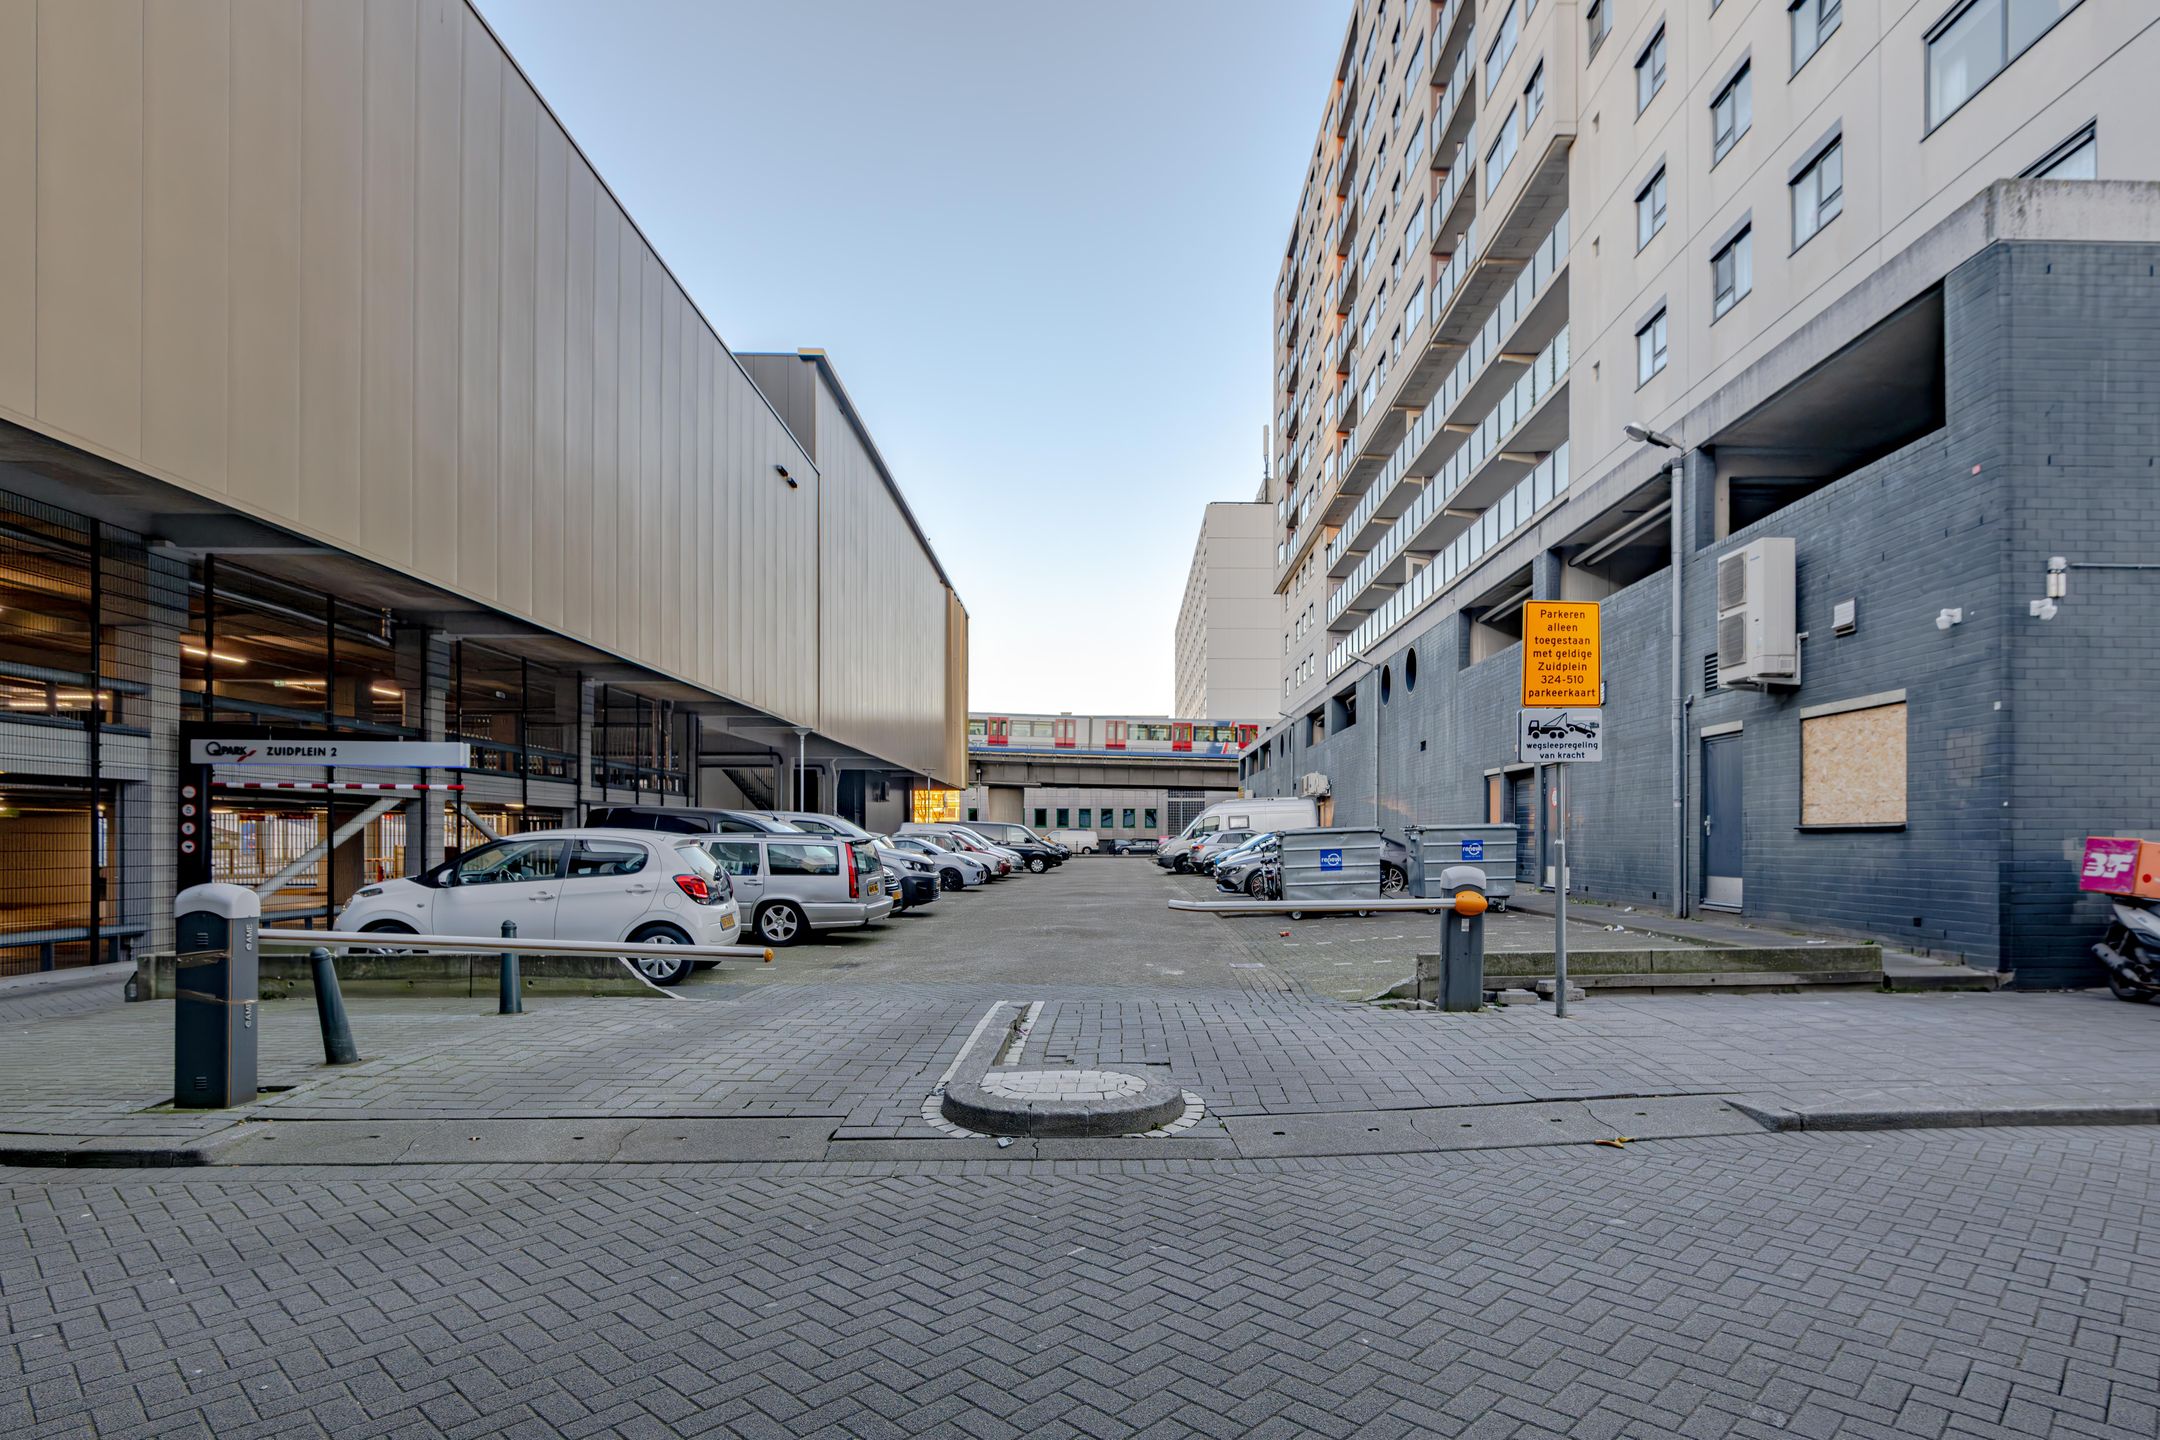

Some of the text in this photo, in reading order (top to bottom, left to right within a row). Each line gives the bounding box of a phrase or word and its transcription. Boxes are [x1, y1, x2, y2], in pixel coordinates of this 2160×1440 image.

[1541, 610, 1585, 619] Parkeren
[1547, 622, 1578, 632] alleen
[1535, 636, 1590, 646] toegestaan
[1533, 649, 1592, 660] met geldige
[1538, 662, 1587, 672] Zuidplein
[1541, 675, 1584, 684] 324-510
[1528, 688, 1595, 698] parkeerkaart
[1526, 741, 1598, 750] wegsleepregeling
[267, 746, 337, 757] ZUIDPLEIN 2
[1558, 751, 1585, 759] kracht
